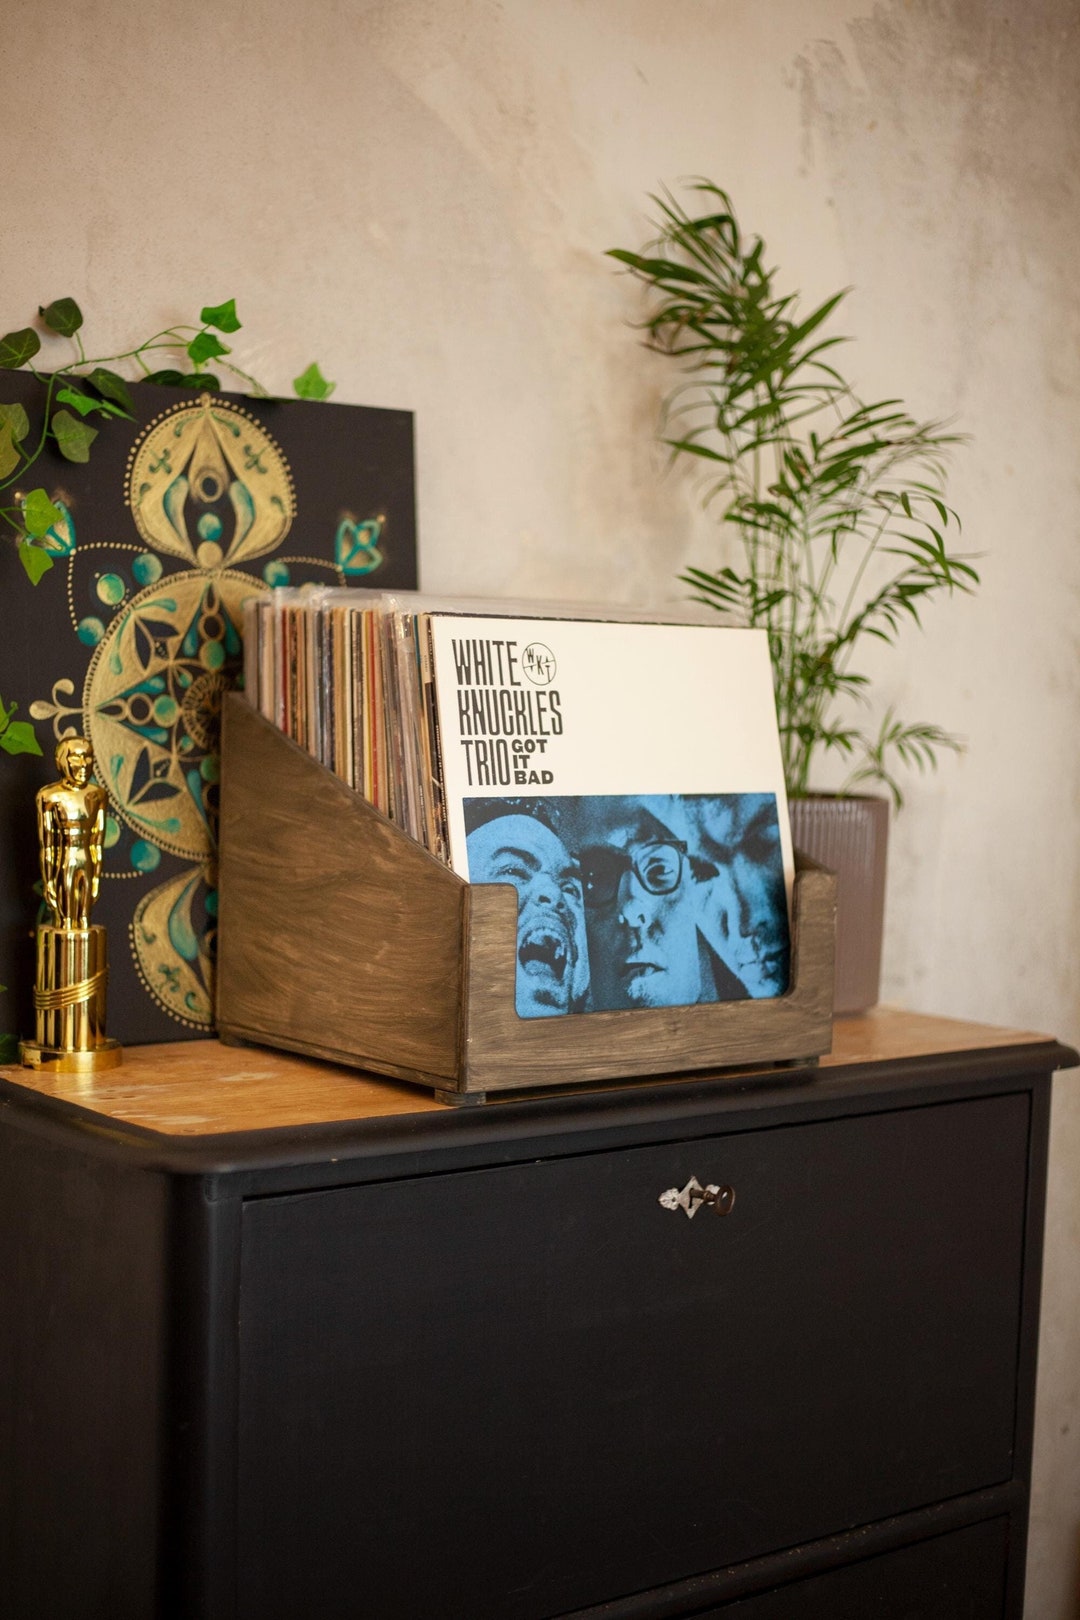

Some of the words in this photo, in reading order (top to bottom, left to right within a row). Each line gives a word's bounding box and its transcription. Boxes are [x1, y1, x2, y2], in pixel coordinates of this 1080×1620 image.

[451, 639, 521, 686] WHITE
[457, 689, 563, 736] KNUCKLES
[511, 739, 547, 753] GOT
[513, 754, 530, 769] IT
[460, 739, 511, 786] TRIO
[514, 770, 554, 785] BAD
